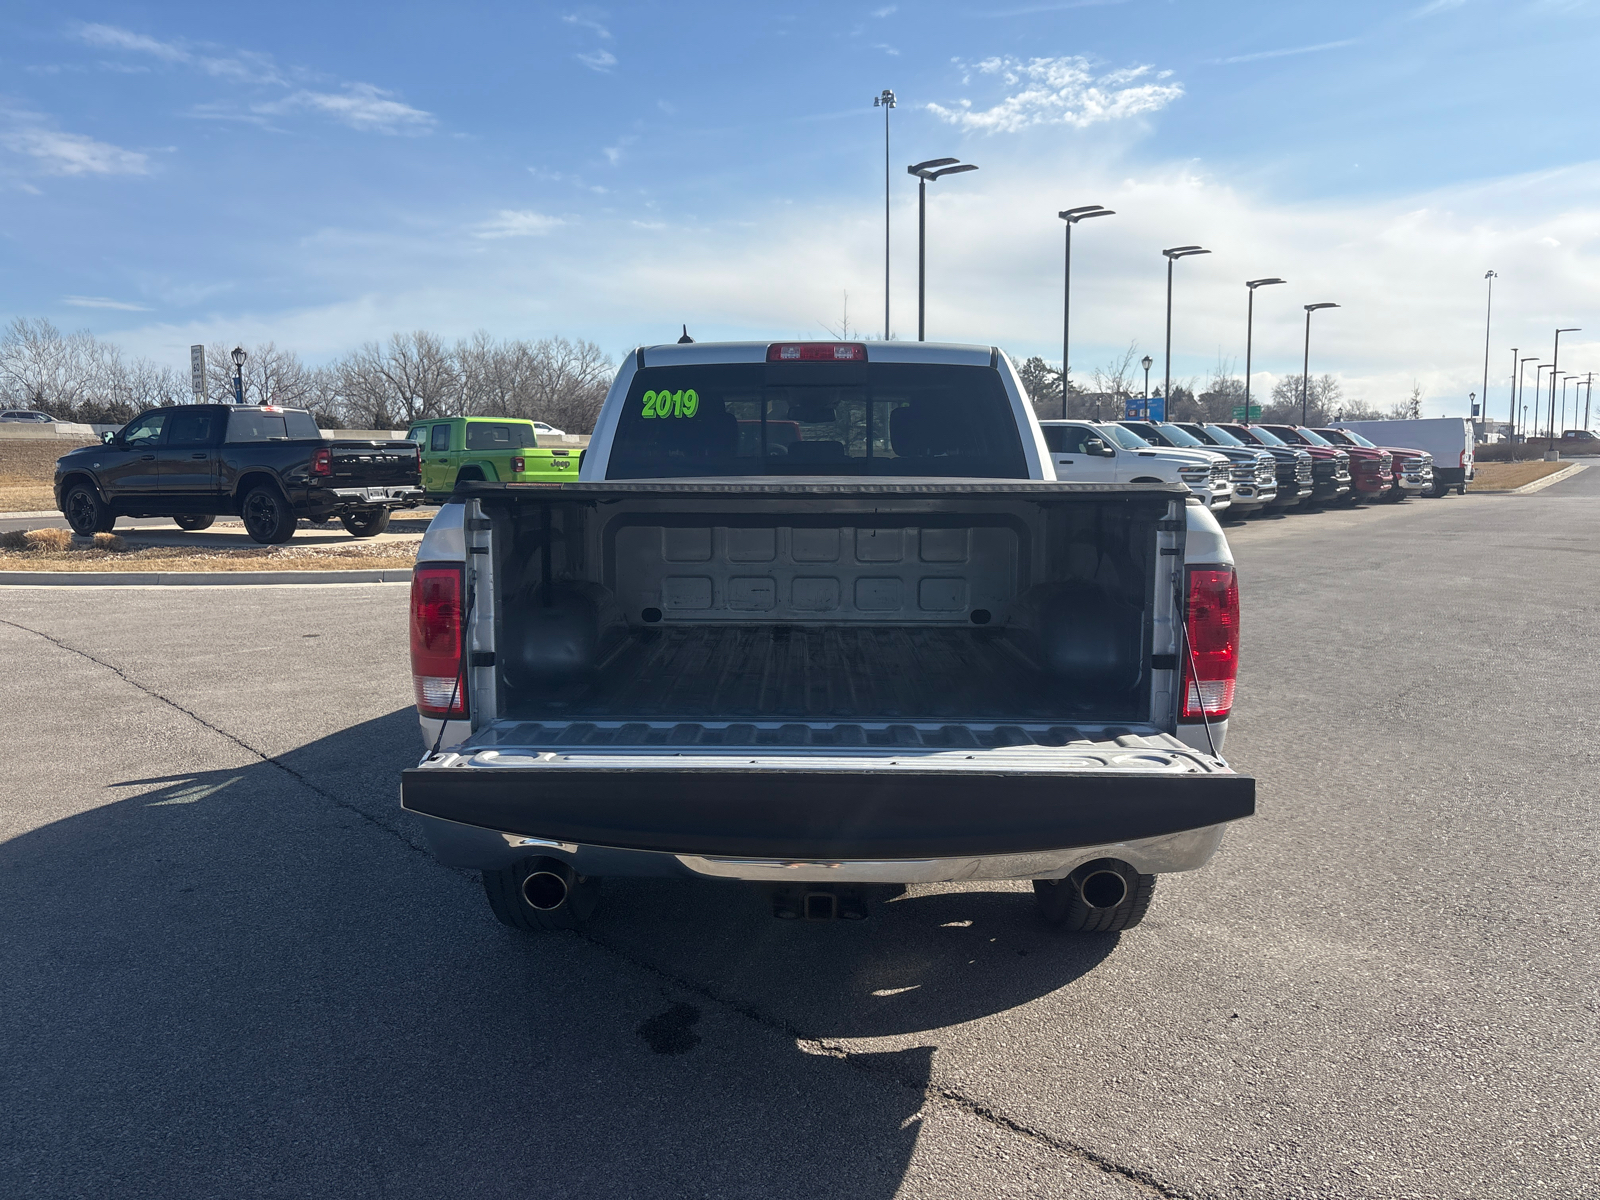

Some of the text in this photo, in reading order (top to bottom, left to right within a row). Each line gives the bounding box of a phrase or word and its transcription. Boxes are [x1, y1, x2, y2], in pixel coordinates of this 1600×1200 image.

[641, 389, 699, 419] 2019
[359, 456, 399, 464] RAM
[550, 458, 570, 469] Jeep
